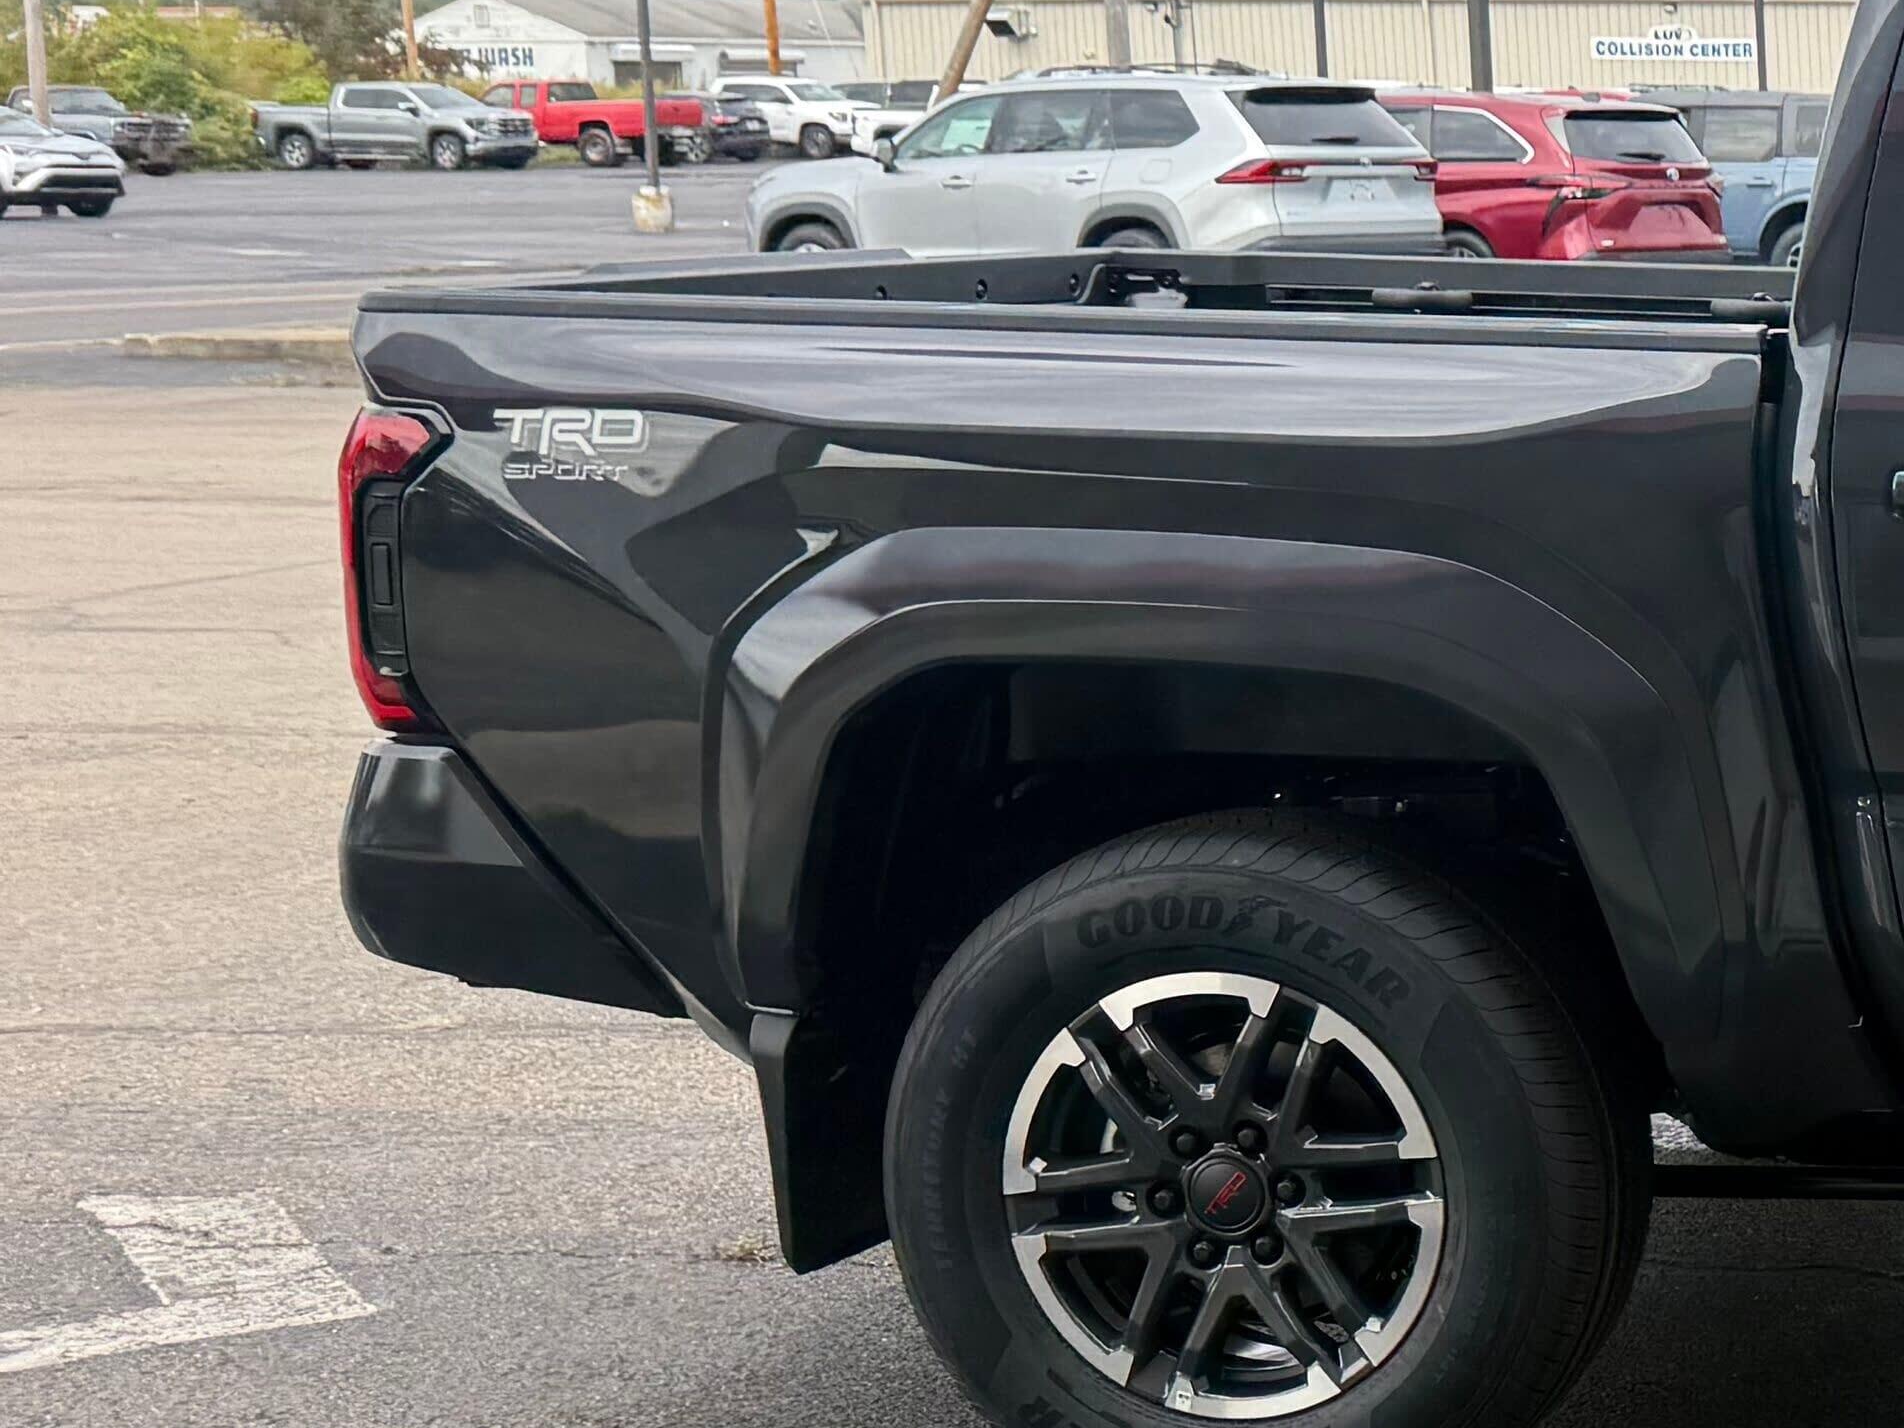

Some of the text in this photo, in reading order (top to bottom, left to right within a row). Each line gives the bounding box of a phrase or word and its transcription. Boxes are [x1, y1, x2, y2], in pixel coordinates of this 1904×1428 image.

[1596, 40, 1753, 58] COLLISION CENTER
[493, 408, 649, 456] TRD
[503, 461, 629, 482] SPORT
